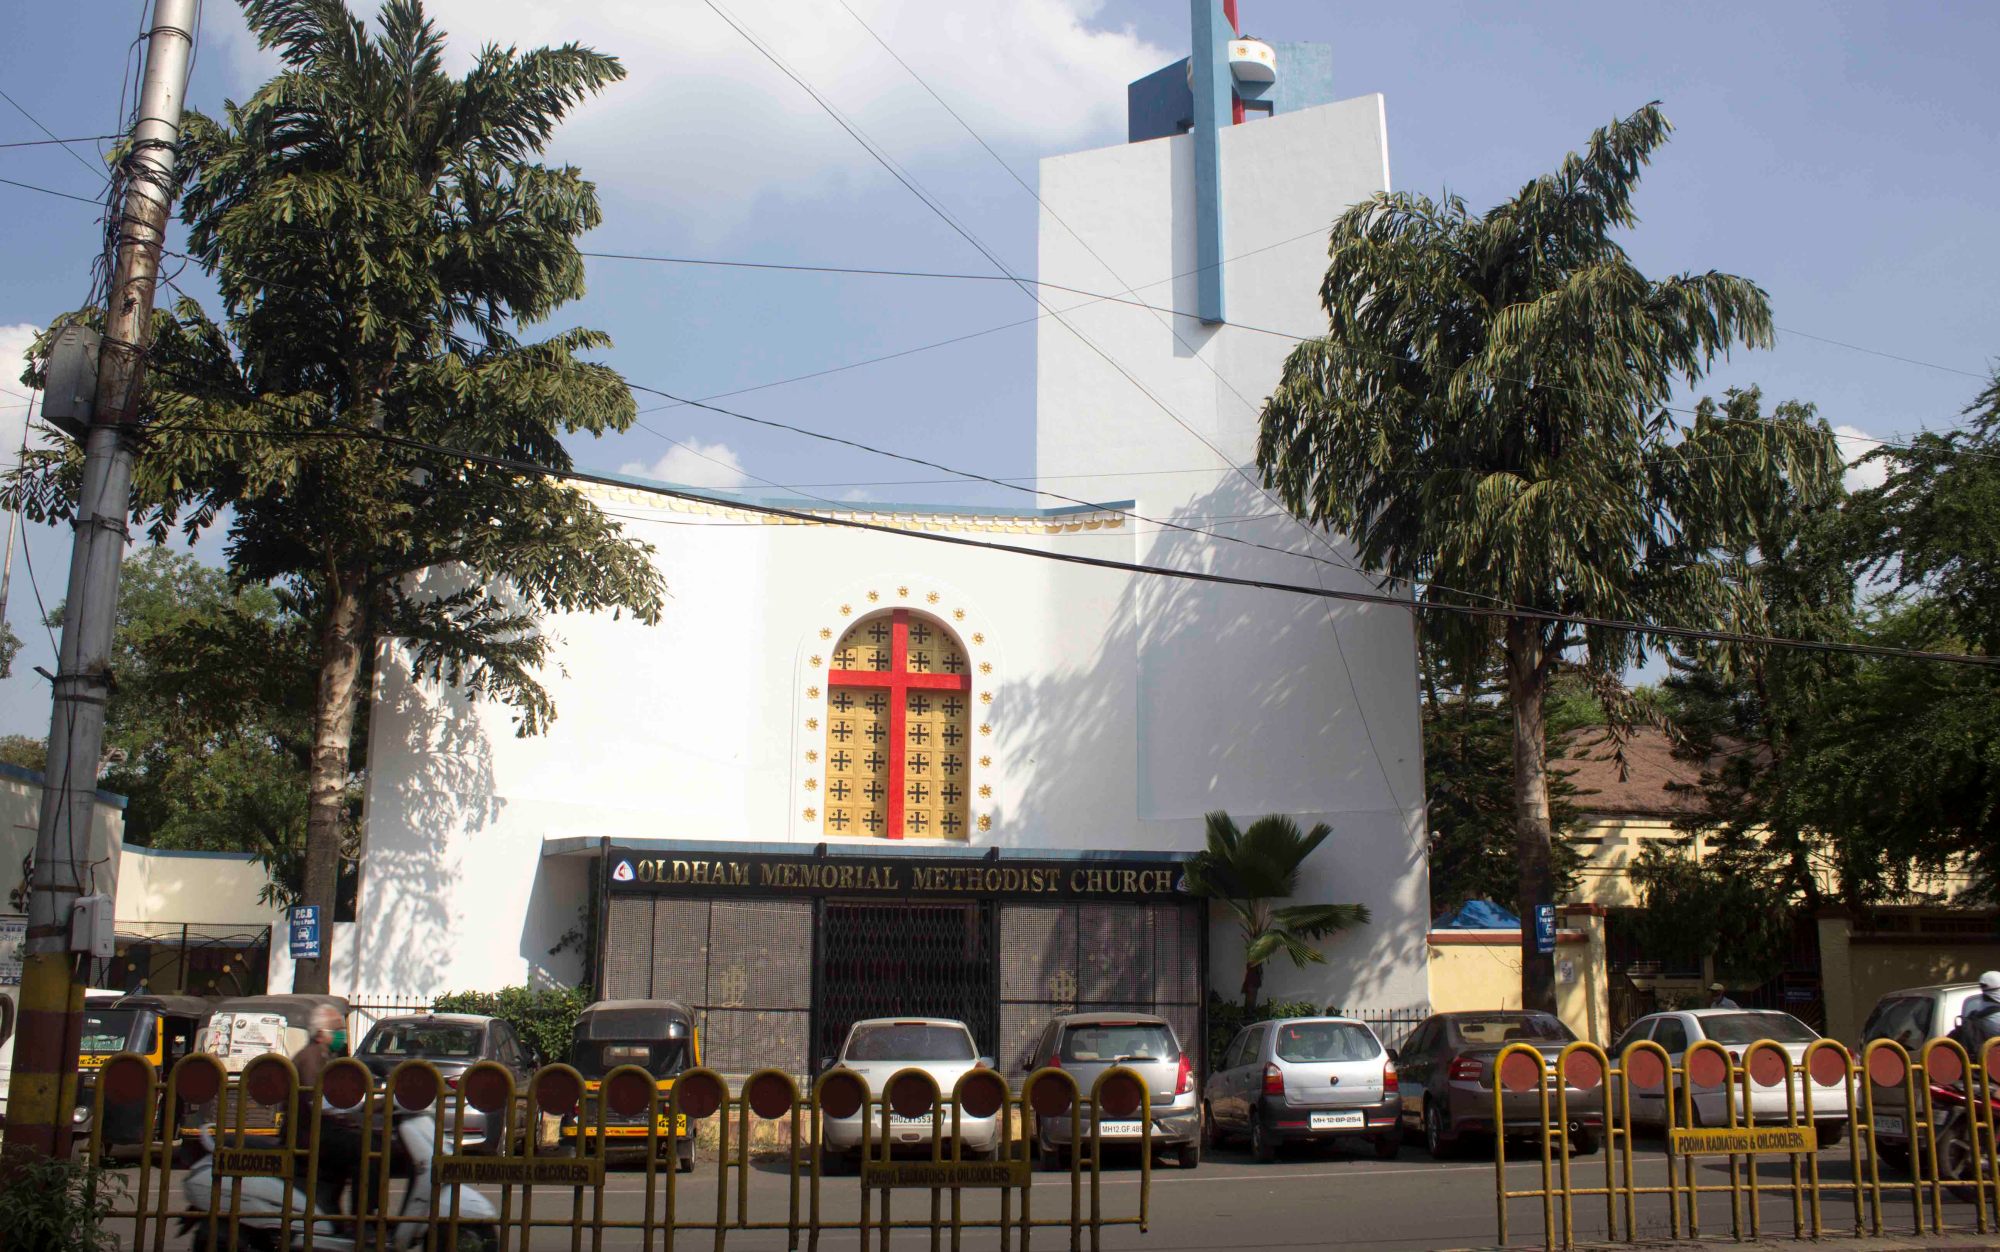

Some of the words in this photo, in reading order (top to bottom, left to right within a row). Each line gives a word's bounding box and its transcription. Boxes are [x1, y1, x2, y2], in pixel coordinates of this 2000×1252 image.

[637, 859, 750, 886] OLDHAM
[760, 863, 899, 890] MEMORIAL
[911, 867, 1060, 893] METHODIST
[1070, 869, 1173, 894] CHURCH
[1679, 1136, 1705, 1152] POONA
[1706, 1135, 1748, 1151] RADIATORS
[1749, 1134, 1755, 1149] &
[1757, 1132, 1805, 1149] OILCOOLERS
